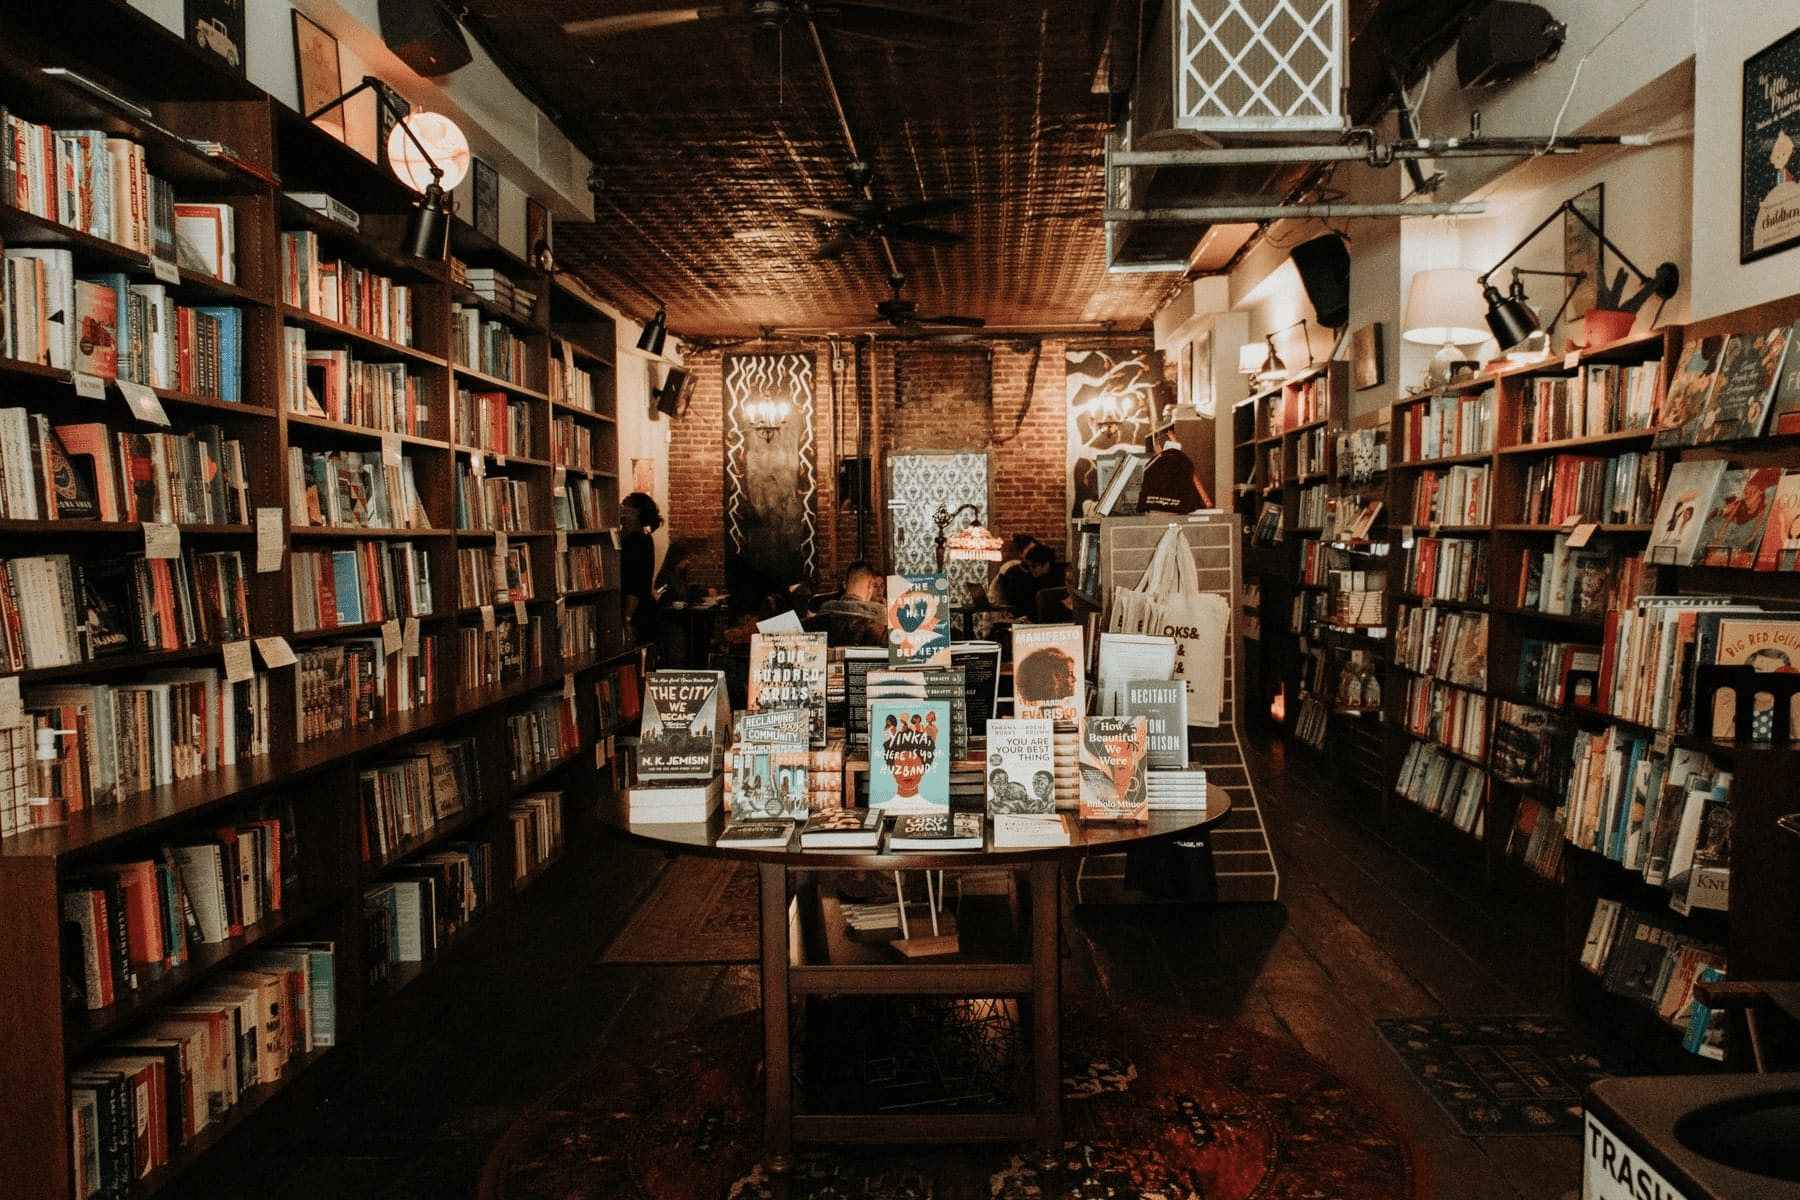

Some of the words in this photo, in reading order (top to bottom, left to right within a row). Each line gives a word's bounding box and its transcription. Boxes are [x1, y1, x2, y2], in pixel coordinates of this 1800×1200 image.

[910, 582, 929, 591] THE
[1016, 629, 1080, 643] MANIFESTO
[769, 650, 804, 665] FOUR
[754, 668, 819, 682] HUNDRED
[649, 686, 677, 700] THE
[679, 686, 714, 700] CITY
[761, 687, 810, 701] SOULS
[1130, 688, 1178, 704] RECITATIF
[669, 702, 688, 713] WE
[660, 713, 697, 721] BECAME
[745, 711, 795, 727] RECLAIMING
[1100, 721, 1124, 731] How
[1146, 719, 1166, 734] ONI
[748, 729, 800, 741] COMMUNITY
[889, 731, 932, 748] YINKA,
[1089, 732, 1138, 743] Beautiful
[1007, 738, 1028, 746] YOU
[1030, 737, 1049, 745] ARE
[908, 748, 918, 759] IS
[996, 745, 1024, 753] YOUR
[1026, 745, 1049, 753] BEST
[1104, 744, 1123, 754] We
[642, 756, 653, 766] N.
[655, 756, 665, 766] K.
[666, 755, 709, 766] JEMISIN
[1020, 753, 1050, 761] THING
[1098, 756, 1128, 766] Were
[904, 825, 948, 833] DOWN
